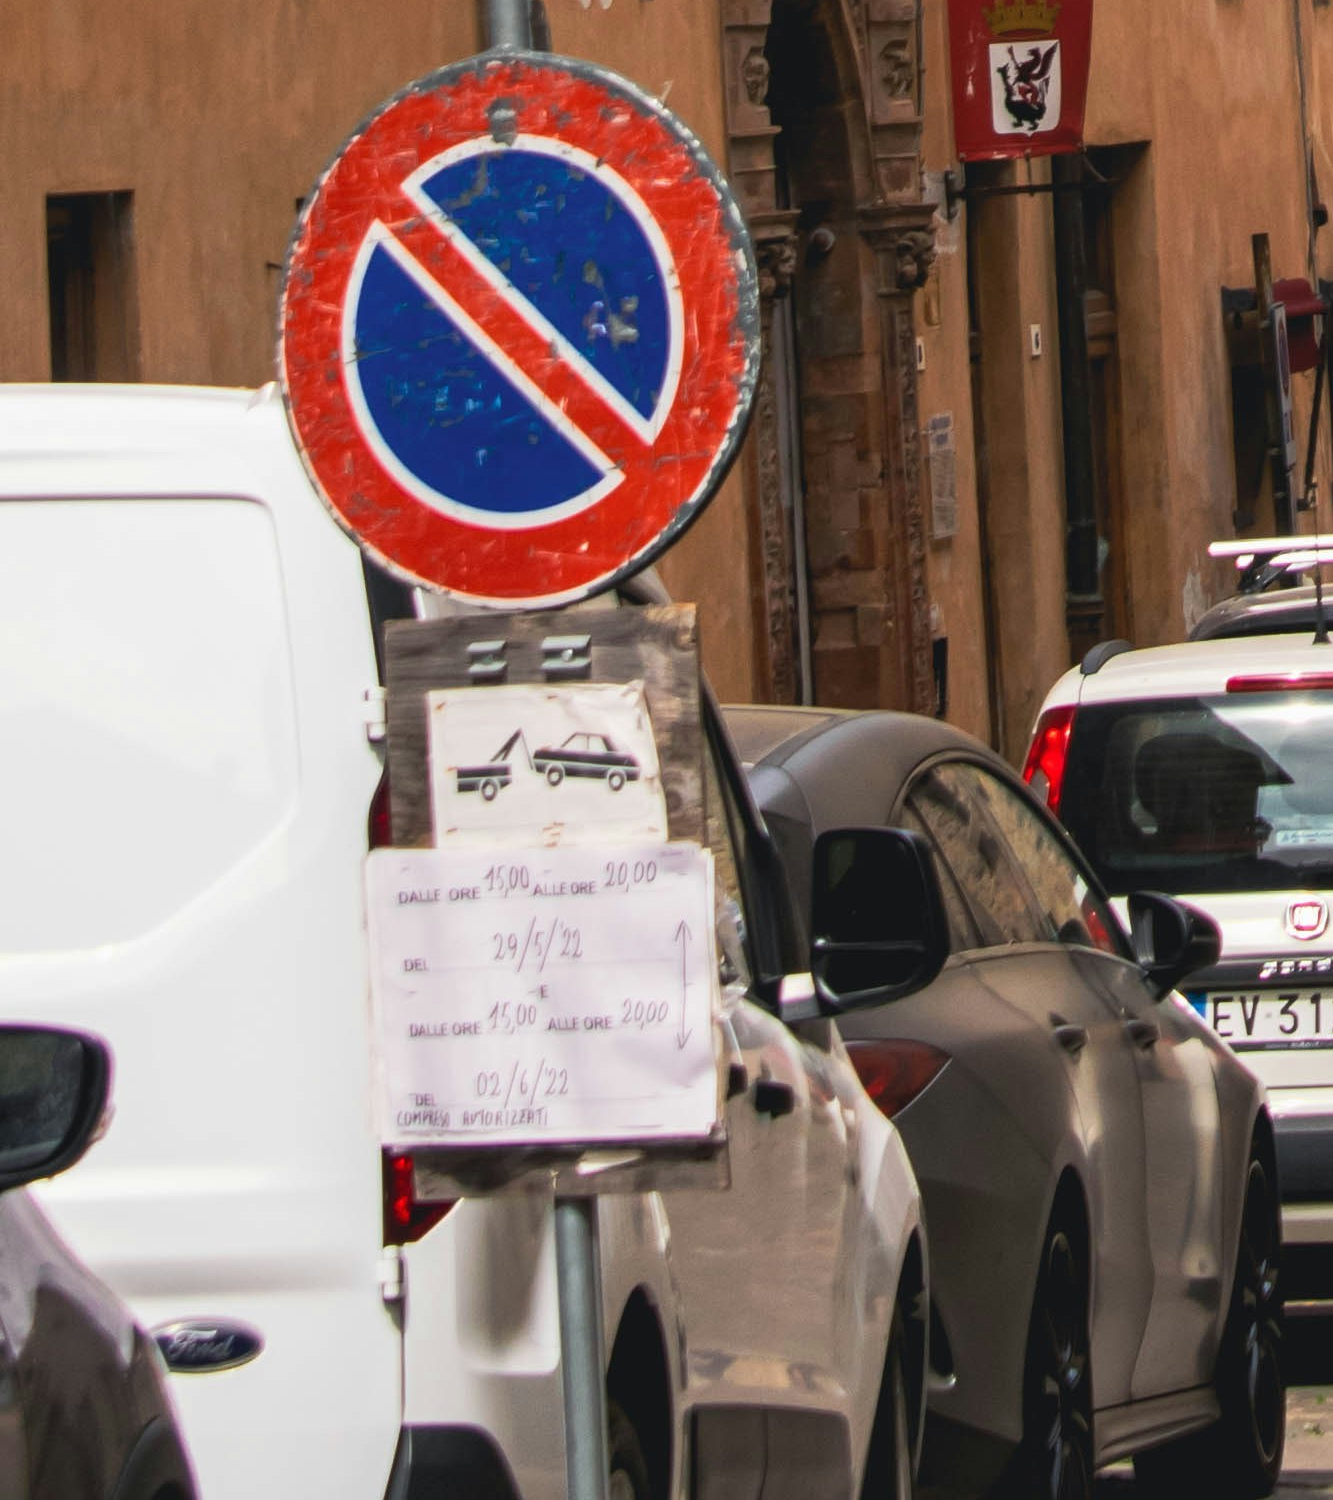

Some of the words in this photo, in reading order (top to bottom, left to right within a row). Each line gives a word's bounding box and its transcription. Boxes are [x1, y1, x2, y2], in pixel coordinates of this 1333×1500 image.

[398, 889, 441, 905] DALLE
[449, 887, 481, 902] ORE
[485, 864, 530, 899] 15,00
[532, 884, 570, 897] ALLE
[571, 881, 597, 895] ORE
[603, 861, 658, 893] 20,00
[403, 958, 429, 972] DEL
[409, 1022, 449, 1037] DALLE
[452, 1021, 482, 1036] ORE
[488, 1001, 537, 1034] 15,00
[547, 1016, 580, 1031] ALLE
[583, 1015, 612, 1030] ORE
[621, 998, 670, 1030] 20,00
[1213, 995, 1260, 1037] EV
[414, 1092, 436, 1106] DEL
[462, 1108, 548, 1127] AUTORIZZATI
